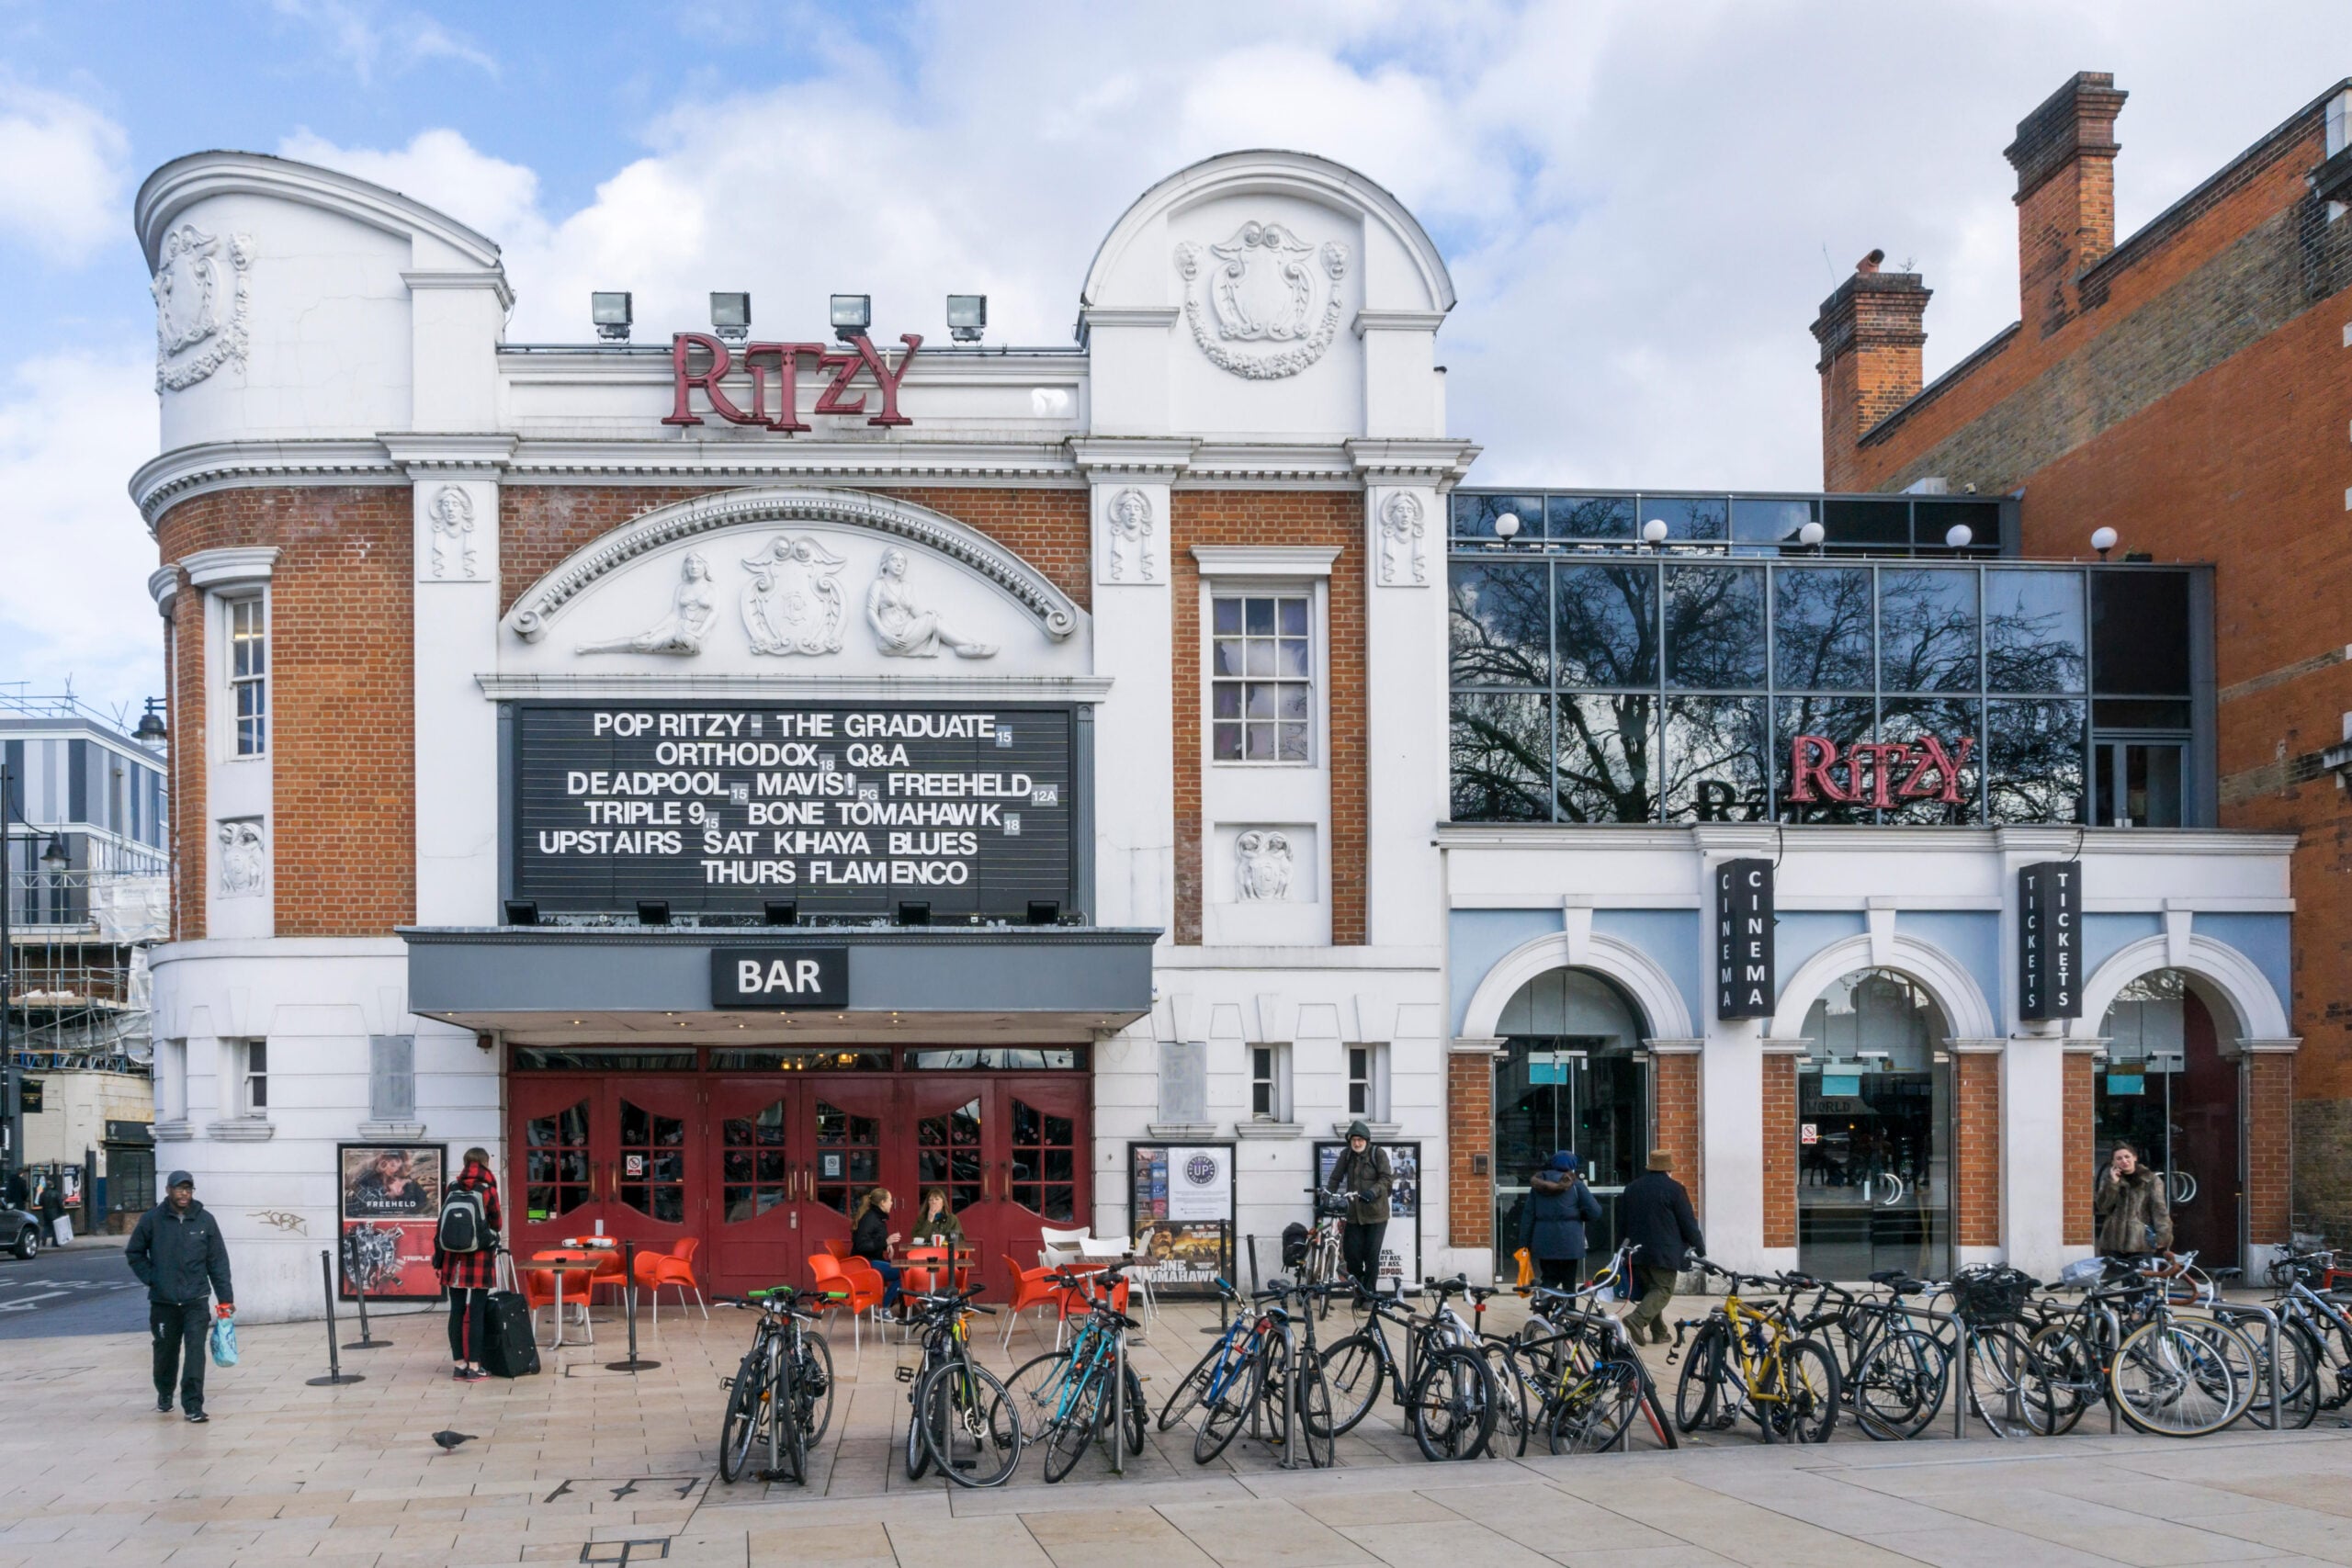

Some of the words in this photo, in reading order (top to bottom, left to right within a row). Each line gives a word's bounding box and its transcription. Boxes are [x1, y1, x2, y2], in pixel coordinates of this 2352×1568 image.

[594, 713, 653, 737] POP
[659, 713, 746, 737] RITZY
[776, 714, 834, 738] THE
[844, 714, 996, 739] GRADUATE
[997, 731, 1012, 743] 15
[655, 742, 819, 767] ORTHODOX
[820, 760, 834, 772] 18
[846, 743, 910, 768] Q&A
[567, 772, 729, 796] DEADPOOL
[732, 788, 747, 800] 15
[756, 772, 854, 796] MAVIS!
[858, 789, 879, 801] PG
[888, 773, 1032, 797] FREEHELD
[1032, 791, 1057, 802] 12A
[584, 801, 682, 825] TRIPLE
[687, 801, 706, 825] 9
[705, 818, 718, 829] 15
[748, 802, 825, 826] BONE
[835, 802, 1002, 827] TOMAHAWK
[1004, 819, 1019, 830] 18
[539, 830, 683, 855] UPSTAIRS
[704, 830, 760, 855] SAT
[774, 831, 872, 855] KHAYA
[888, 832, 979, 856] BLUES
[700, 861, 797, 885] THURS
[809, 861, 968, 886] FLAMENCO
[1722, 874, 1732, 1007] CINEMA
[1747, 871, 1765, 1005] CINEMA
[2027, 875, 2036, 1008] TICKETS
[2058, 873, 2069, 1007] TICKETS
[738, 960, 822, 994] BAR
[1194, 1165, 1209, 1176] UP
[1150, 1270, 1218, 1282] OMAHAWK
